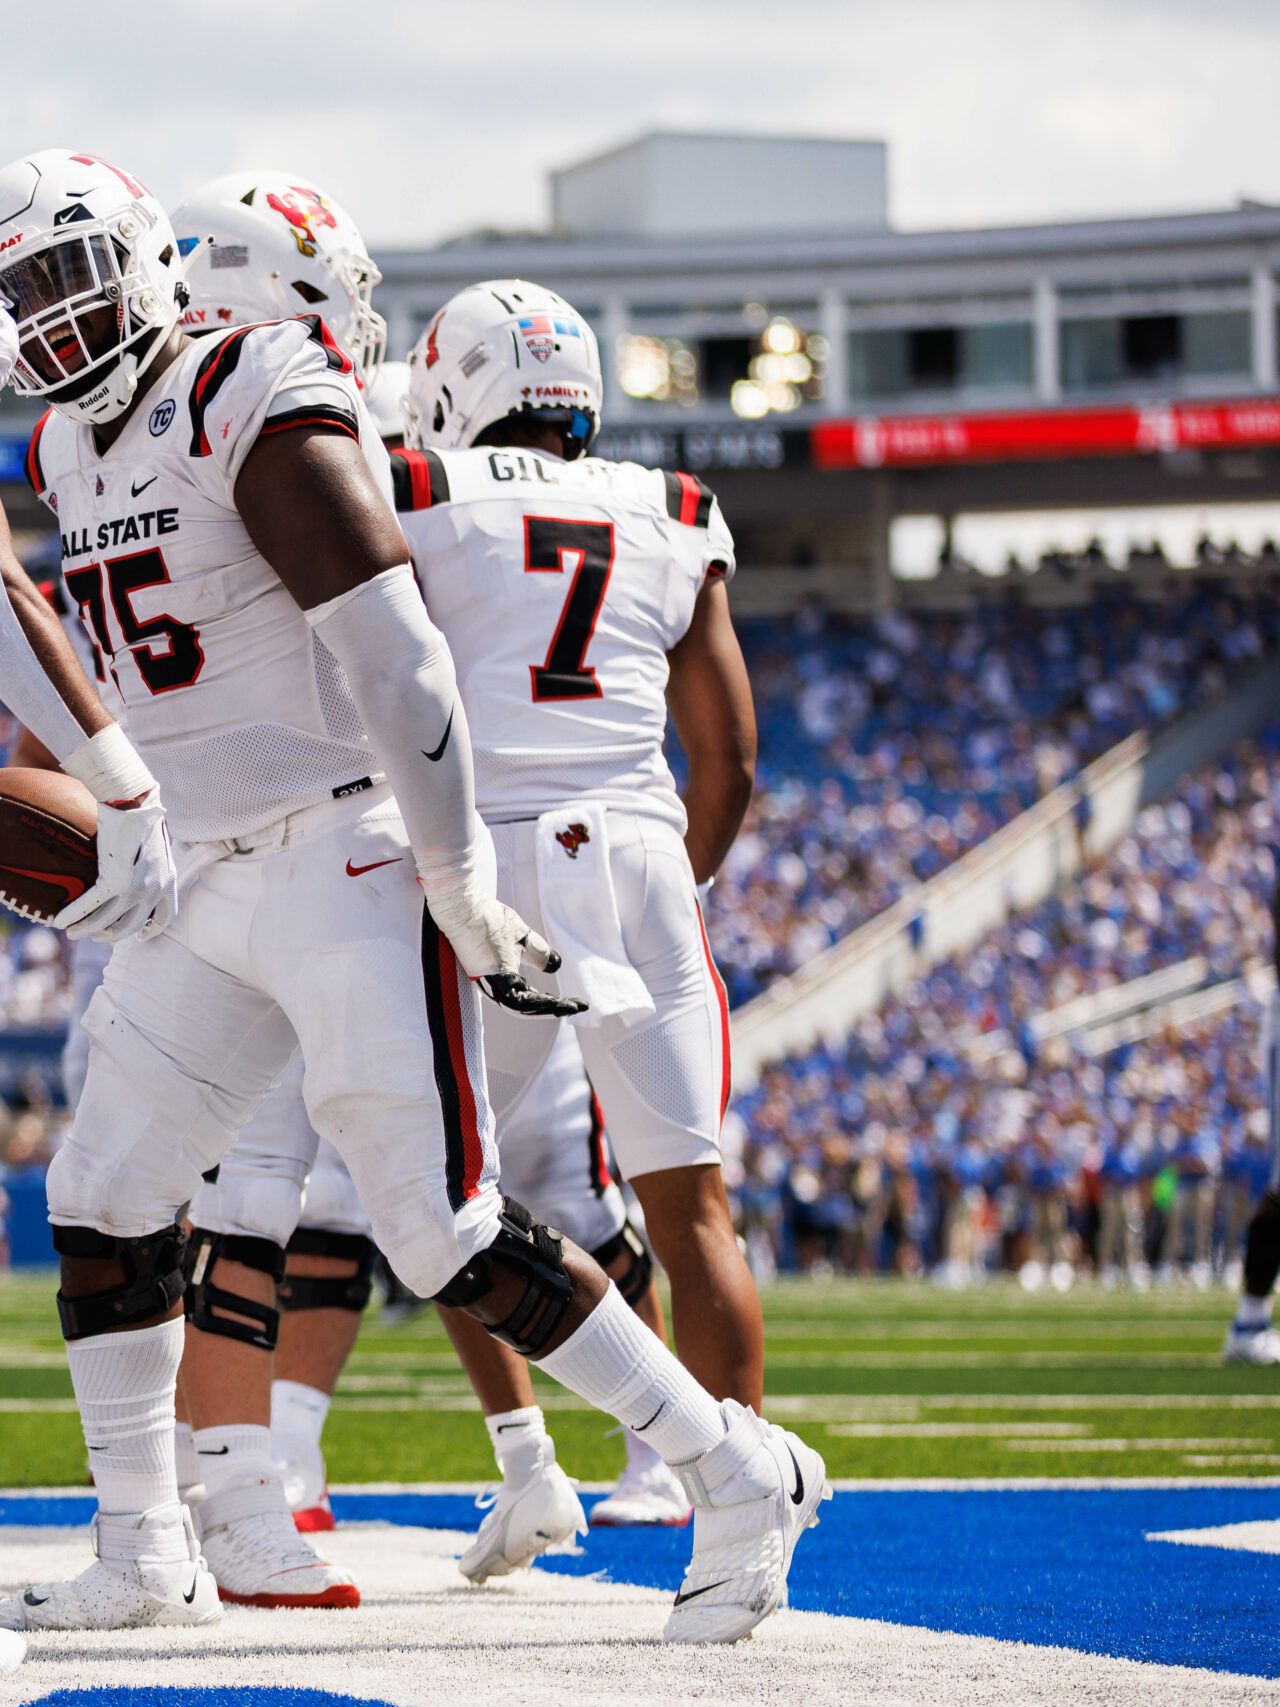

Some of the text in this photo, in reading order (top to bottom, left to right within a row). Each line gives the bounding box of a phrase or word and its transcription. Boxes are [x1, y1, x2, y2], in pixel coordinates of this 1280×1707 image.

[78, 386, 110, 411] Riddell
[535, 387, 580, 398] FAMILY
[153, 406, 172, 428] TC
[96, 507, 179, 550] STATE
[64, 546, 206, 696] 75
[523, 515, 615, 703] 7
